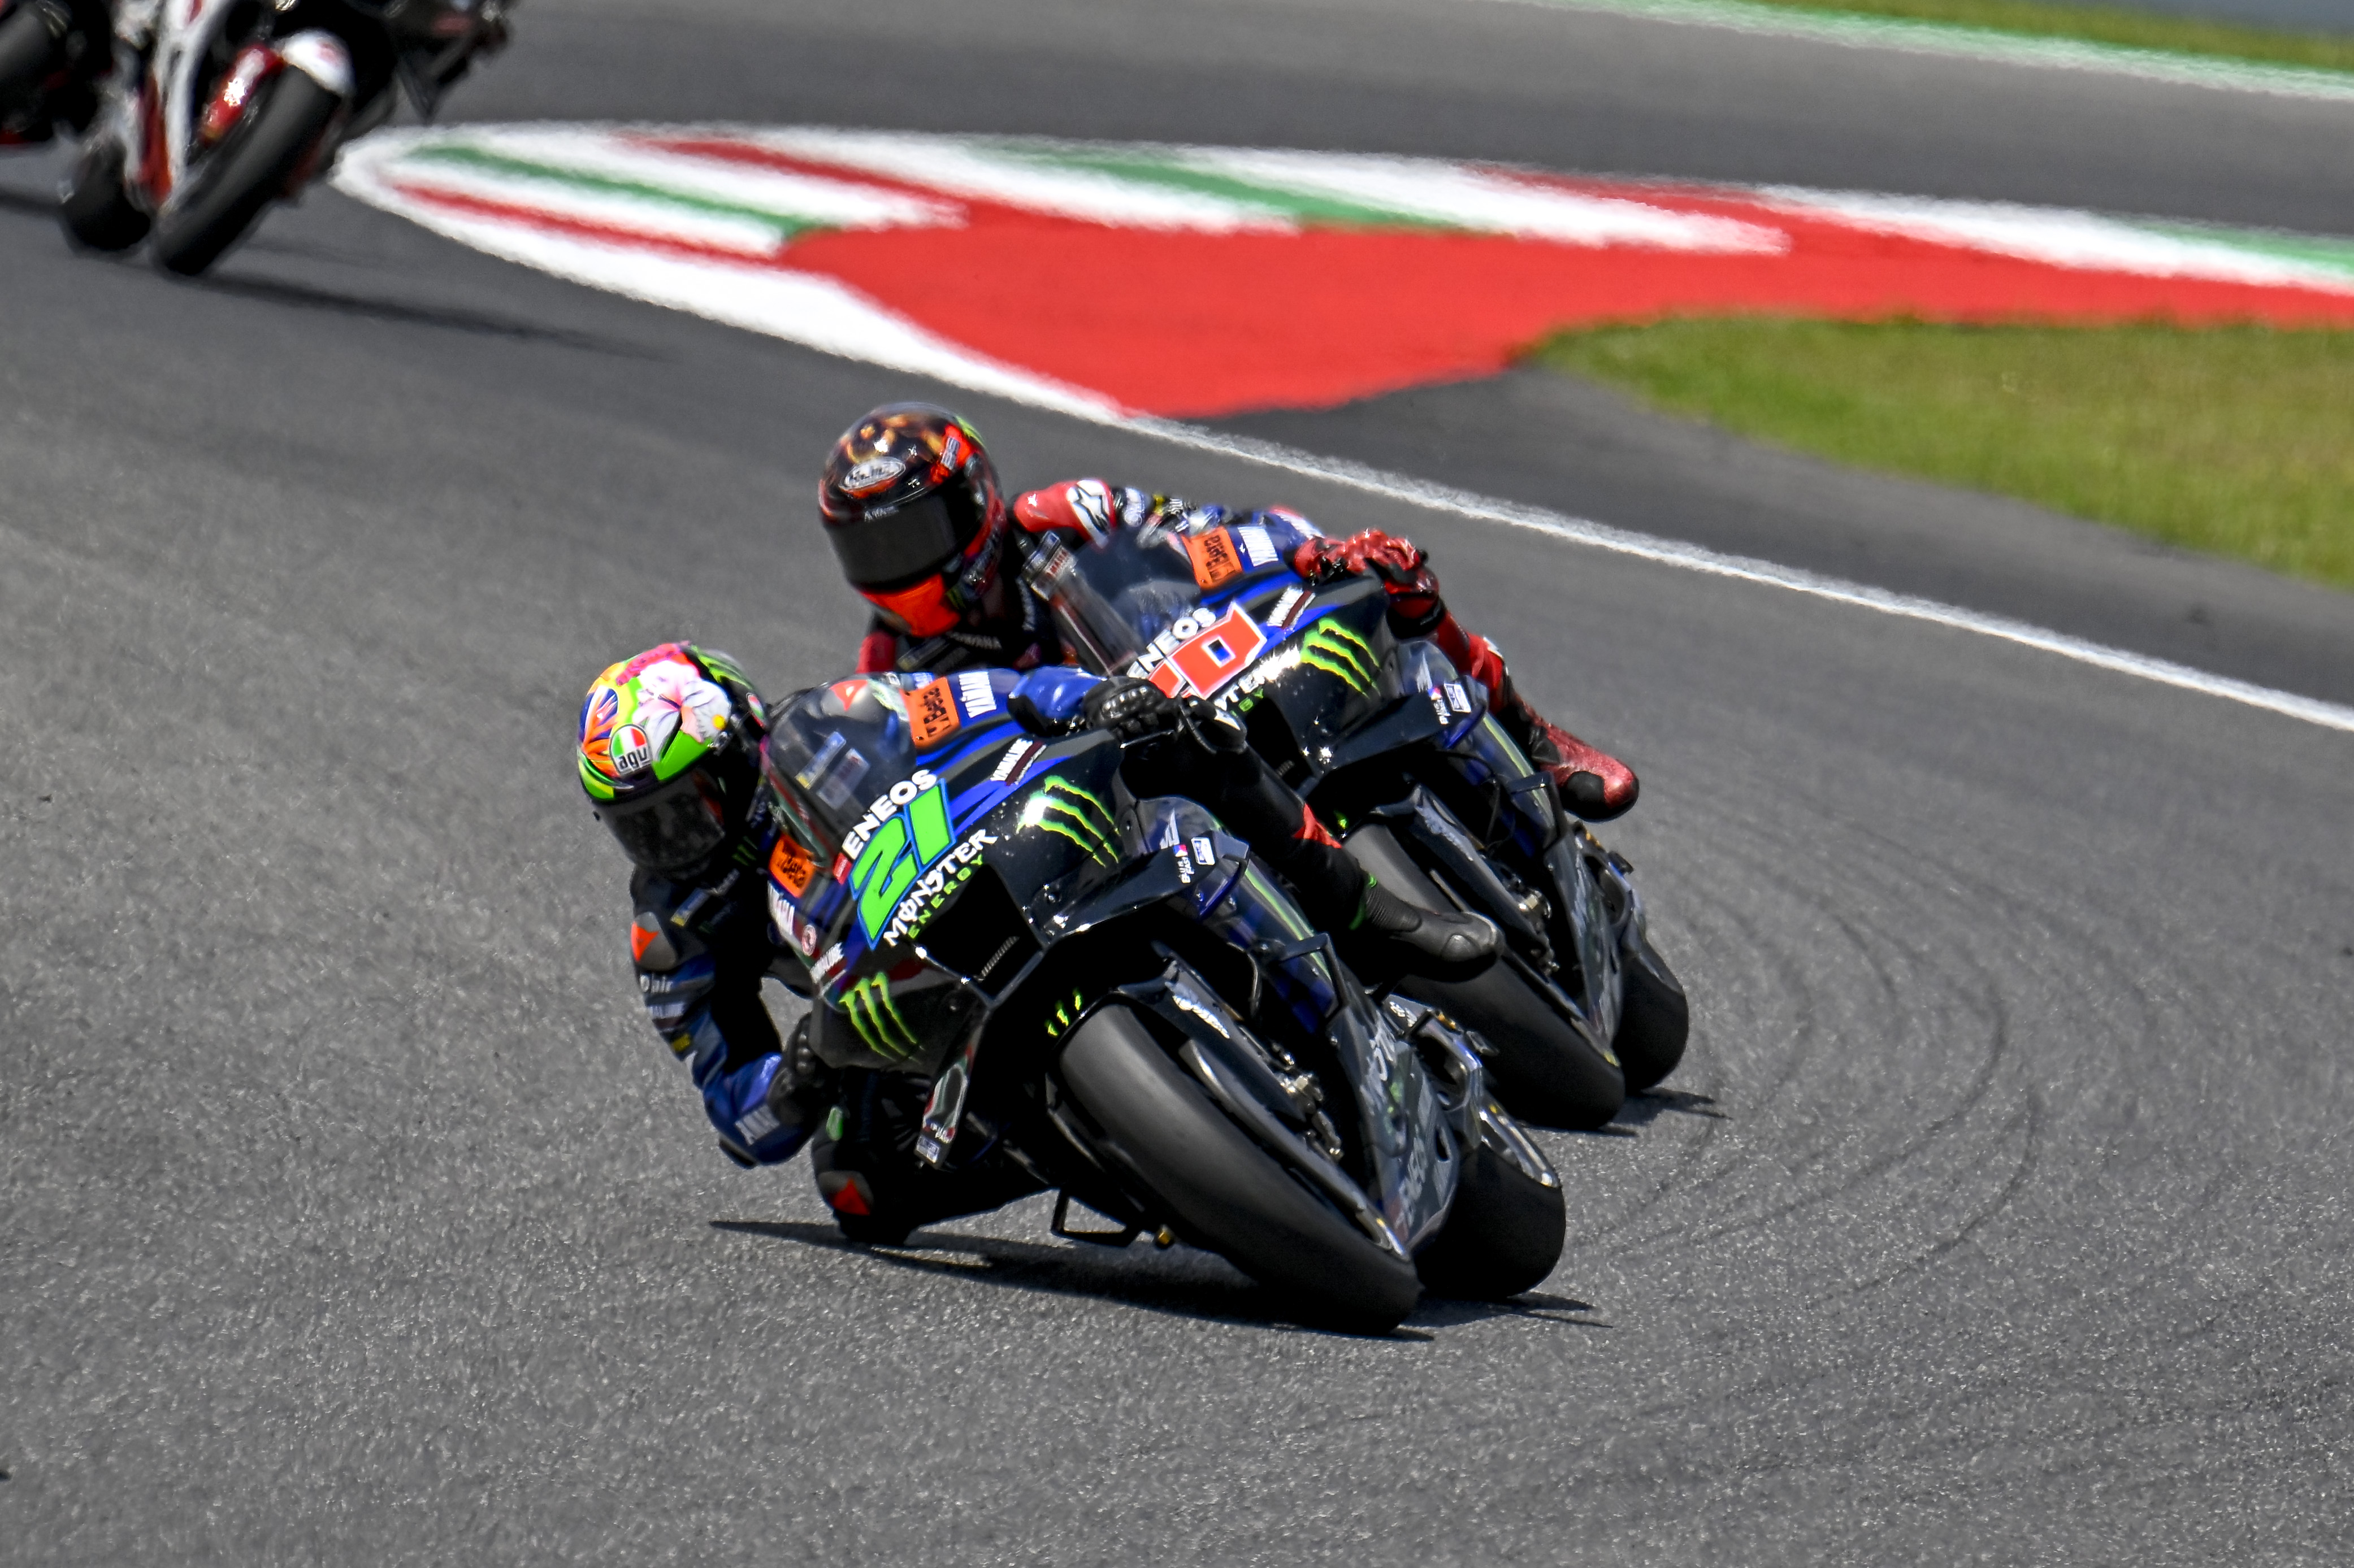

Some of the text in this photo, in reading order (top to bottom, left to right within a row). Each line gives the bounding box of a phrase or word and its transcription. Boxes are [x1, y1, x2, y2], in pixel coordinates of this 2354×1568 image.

[1126, 607, 1216, 679] ENEOS
[842, 769, 937, 859] ENEOS
[849, 778, 956, 950] 21
[883, 829, 999, 948] MONSTER
